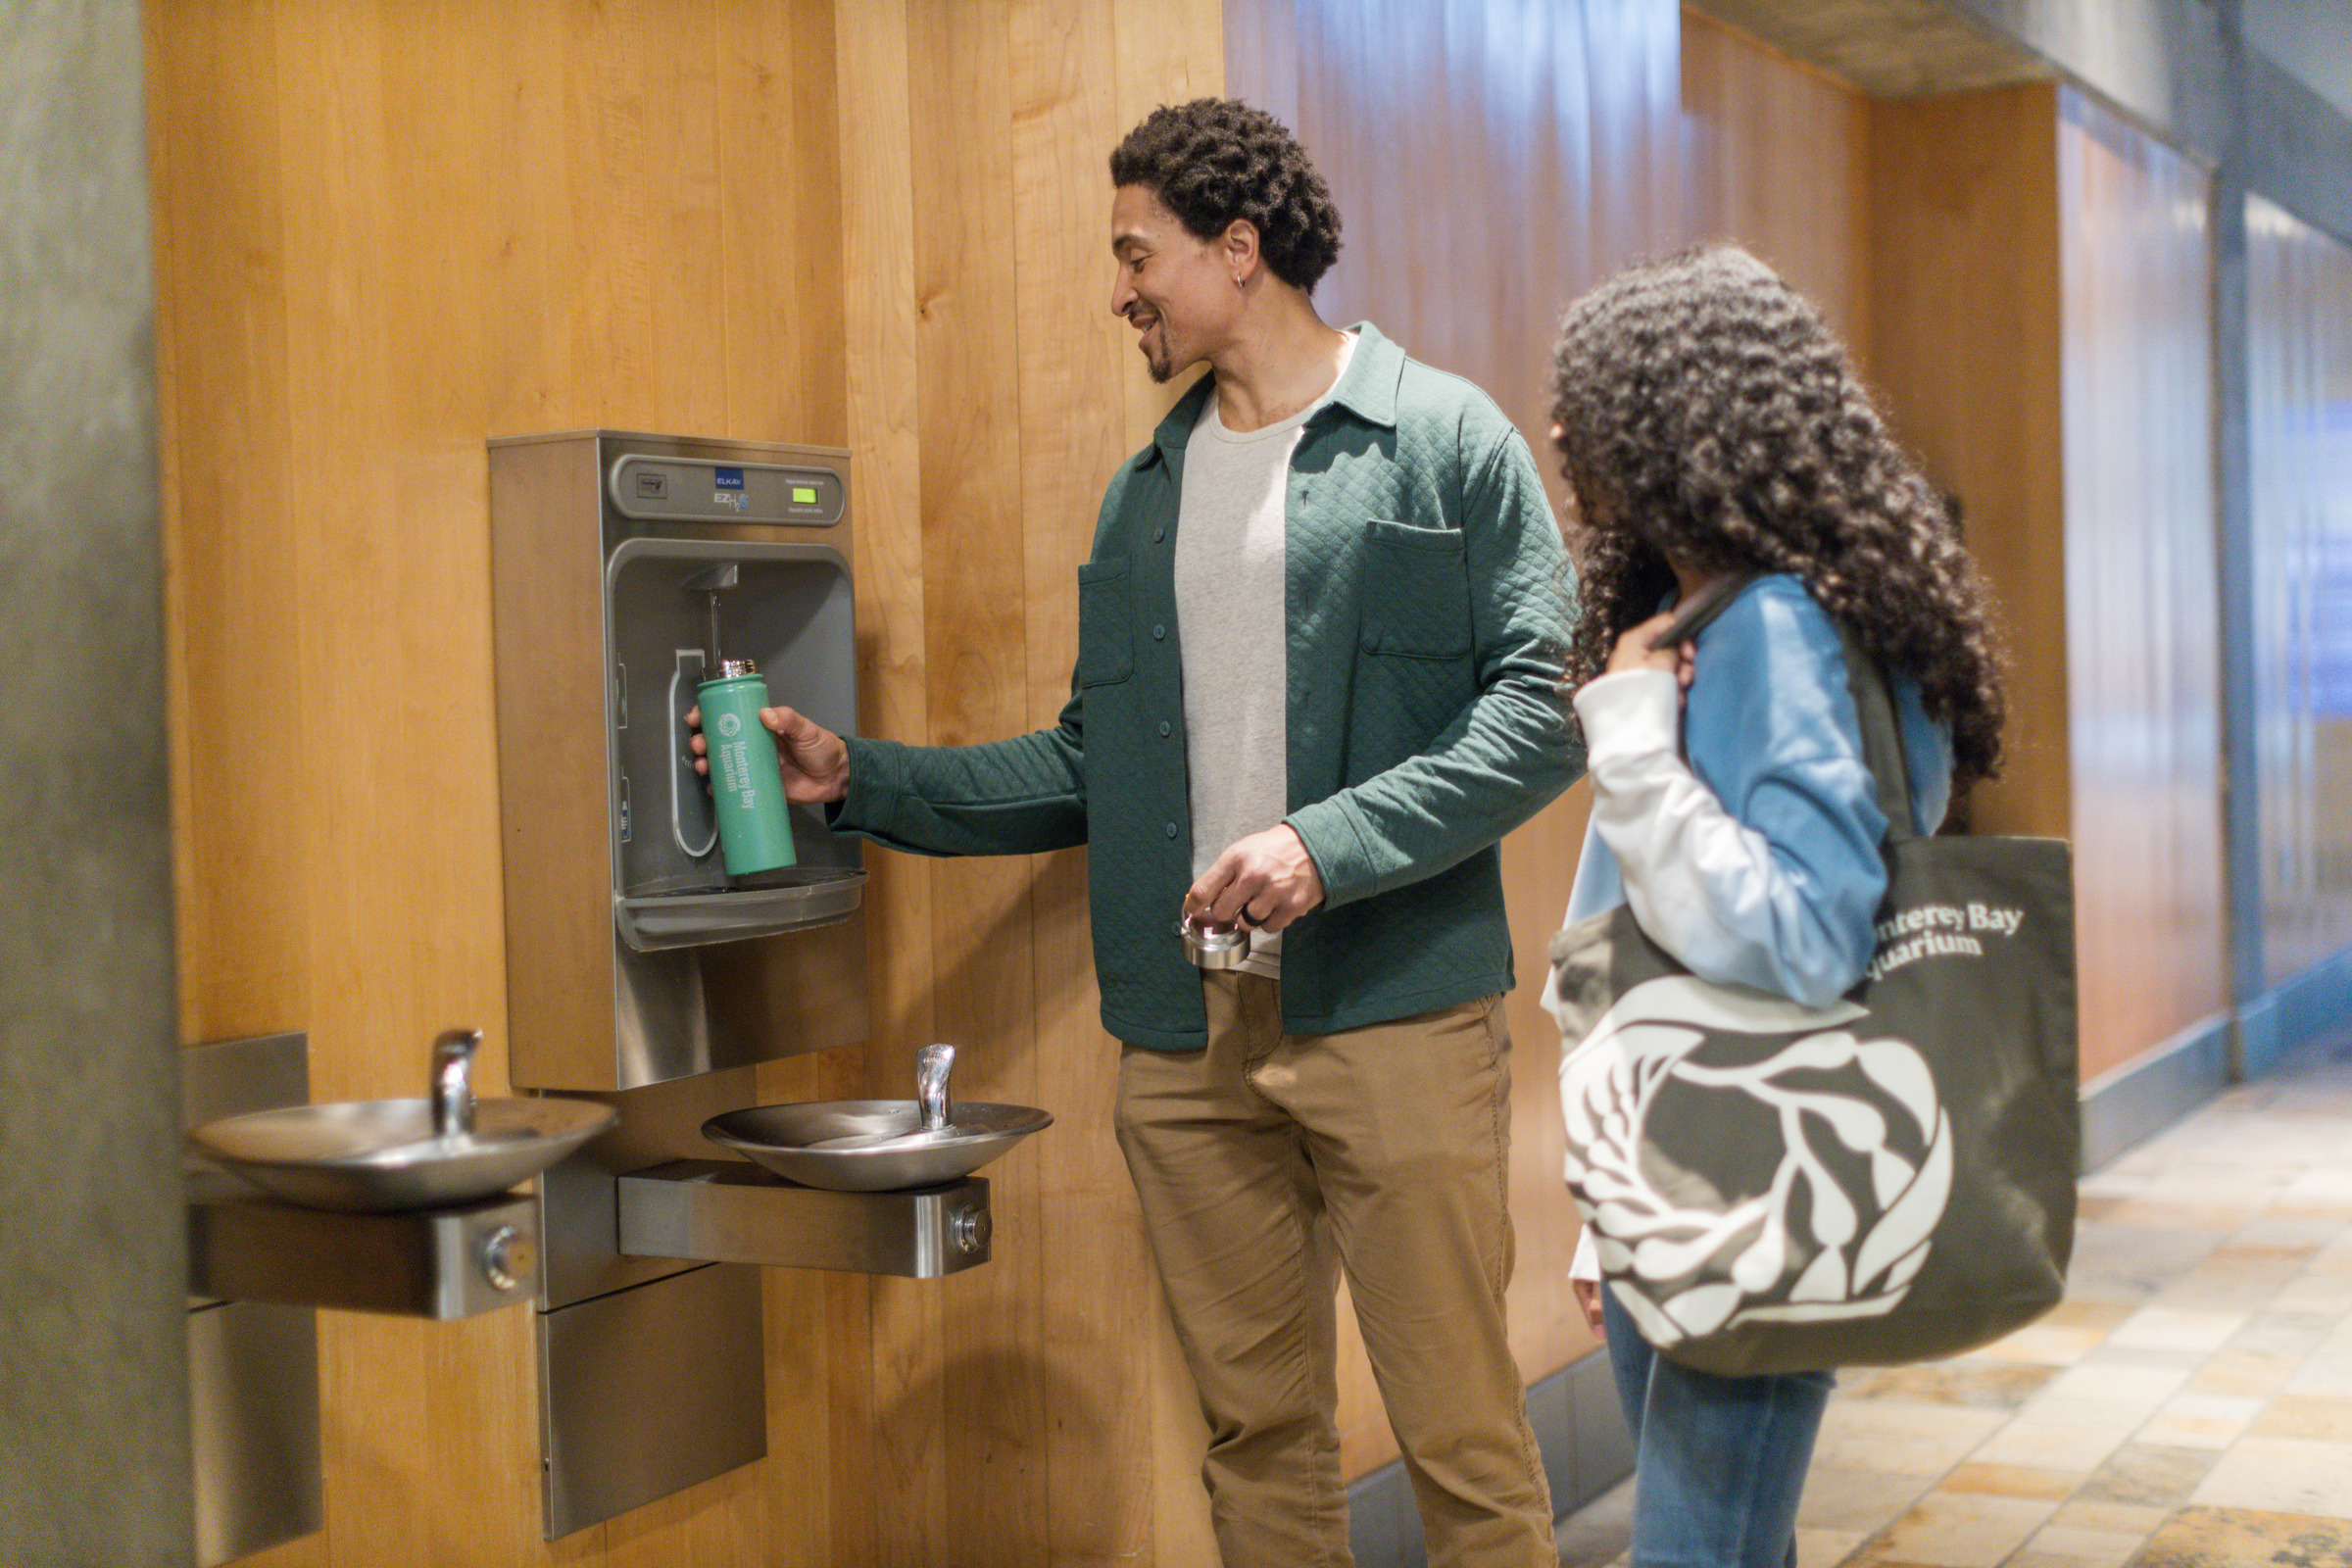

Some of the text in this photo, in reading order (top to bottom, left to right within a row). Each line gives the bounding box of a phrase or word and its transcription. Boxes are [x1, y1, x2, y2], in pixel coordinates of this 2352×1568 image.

[720, 744, 737, 793] Aquarium
[733, 741, 756, 808] Monterey Bay
[1877, 903, 2026, 940] nterey Bay
[1866, 930, 1984, 981] quarium
